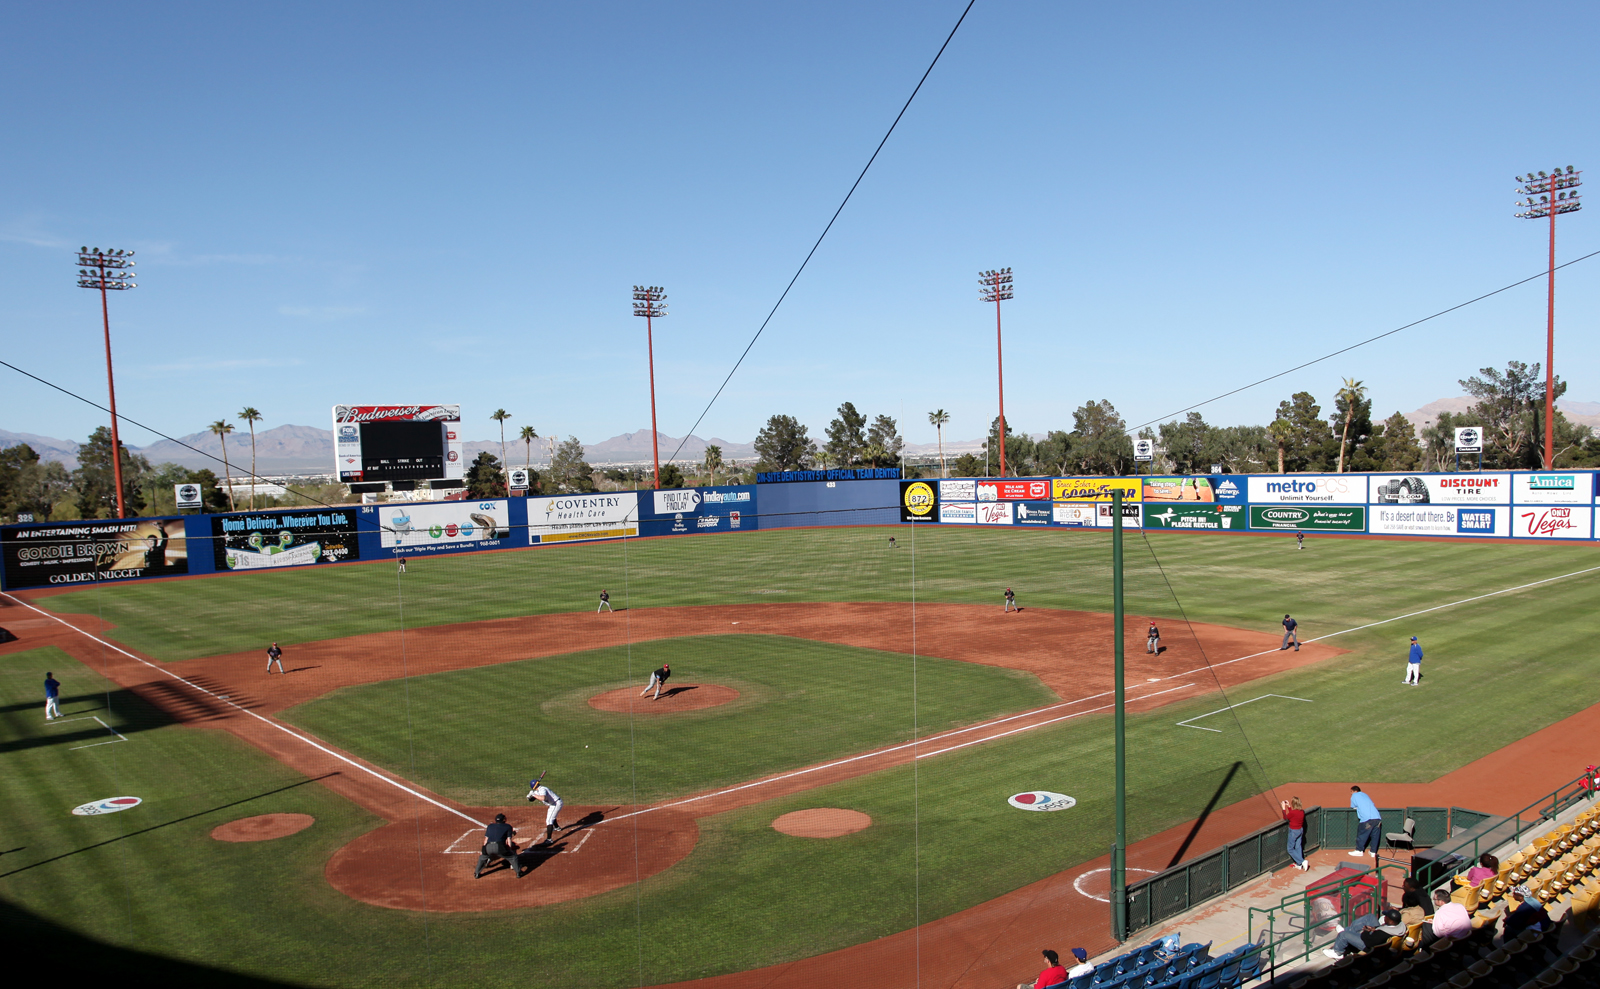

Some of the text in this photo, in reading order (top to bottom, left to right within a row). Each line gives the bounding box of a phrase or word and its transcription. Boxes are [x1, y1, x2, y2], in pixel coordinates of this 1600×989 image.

[338, 406, 420, 423] Budweiser
[757, 472, 780, 482] ON-SITE
[782, 470, 816, 481] DENTISTRY
[827, 470, 855, 480] OFFICIAL
[857, 469, 873, 479] TEAM
[875, 468, 900, 478] DENTIST
[1056, 480, 1072, 488] Bruce
[1440, 479, 1498, 487] DISCOUNT
[1530, 476, 1573, 487] Amica
[664, 493, 689, 502] FIND IT AT
[703, 491, 750, 503] findlayauto.com
[1062, 488, 1136, 498] GOODYR
[556, 498, 620, 510] COVENTRY
[666, 502, 687, 511] FINDLAY
[558, 511, 584, 519] Health
[982, 506, 1009, 523] Vegas
[1380, 511, 1454, 522] It's a desert out there. Be
[1462, 513, 1490, 521] WATER
[1552, 508, 1570, 517] ONLY
[222, 518, 245, 531] Home
[317, 514, 331, 526] You
[332, 512, 348, 525] Live.
[1461, 521, 1490, 529] SMART
[1521, 510, 1577, 536] Vegas
[31, 527, 90, 538] ENTERTAINING
[92, 525, 118, 534] SMASH
[18, 542, 130, 560] GORDIE BROWN
[50, 569, 141, 584] GOLDEN NUGGET
